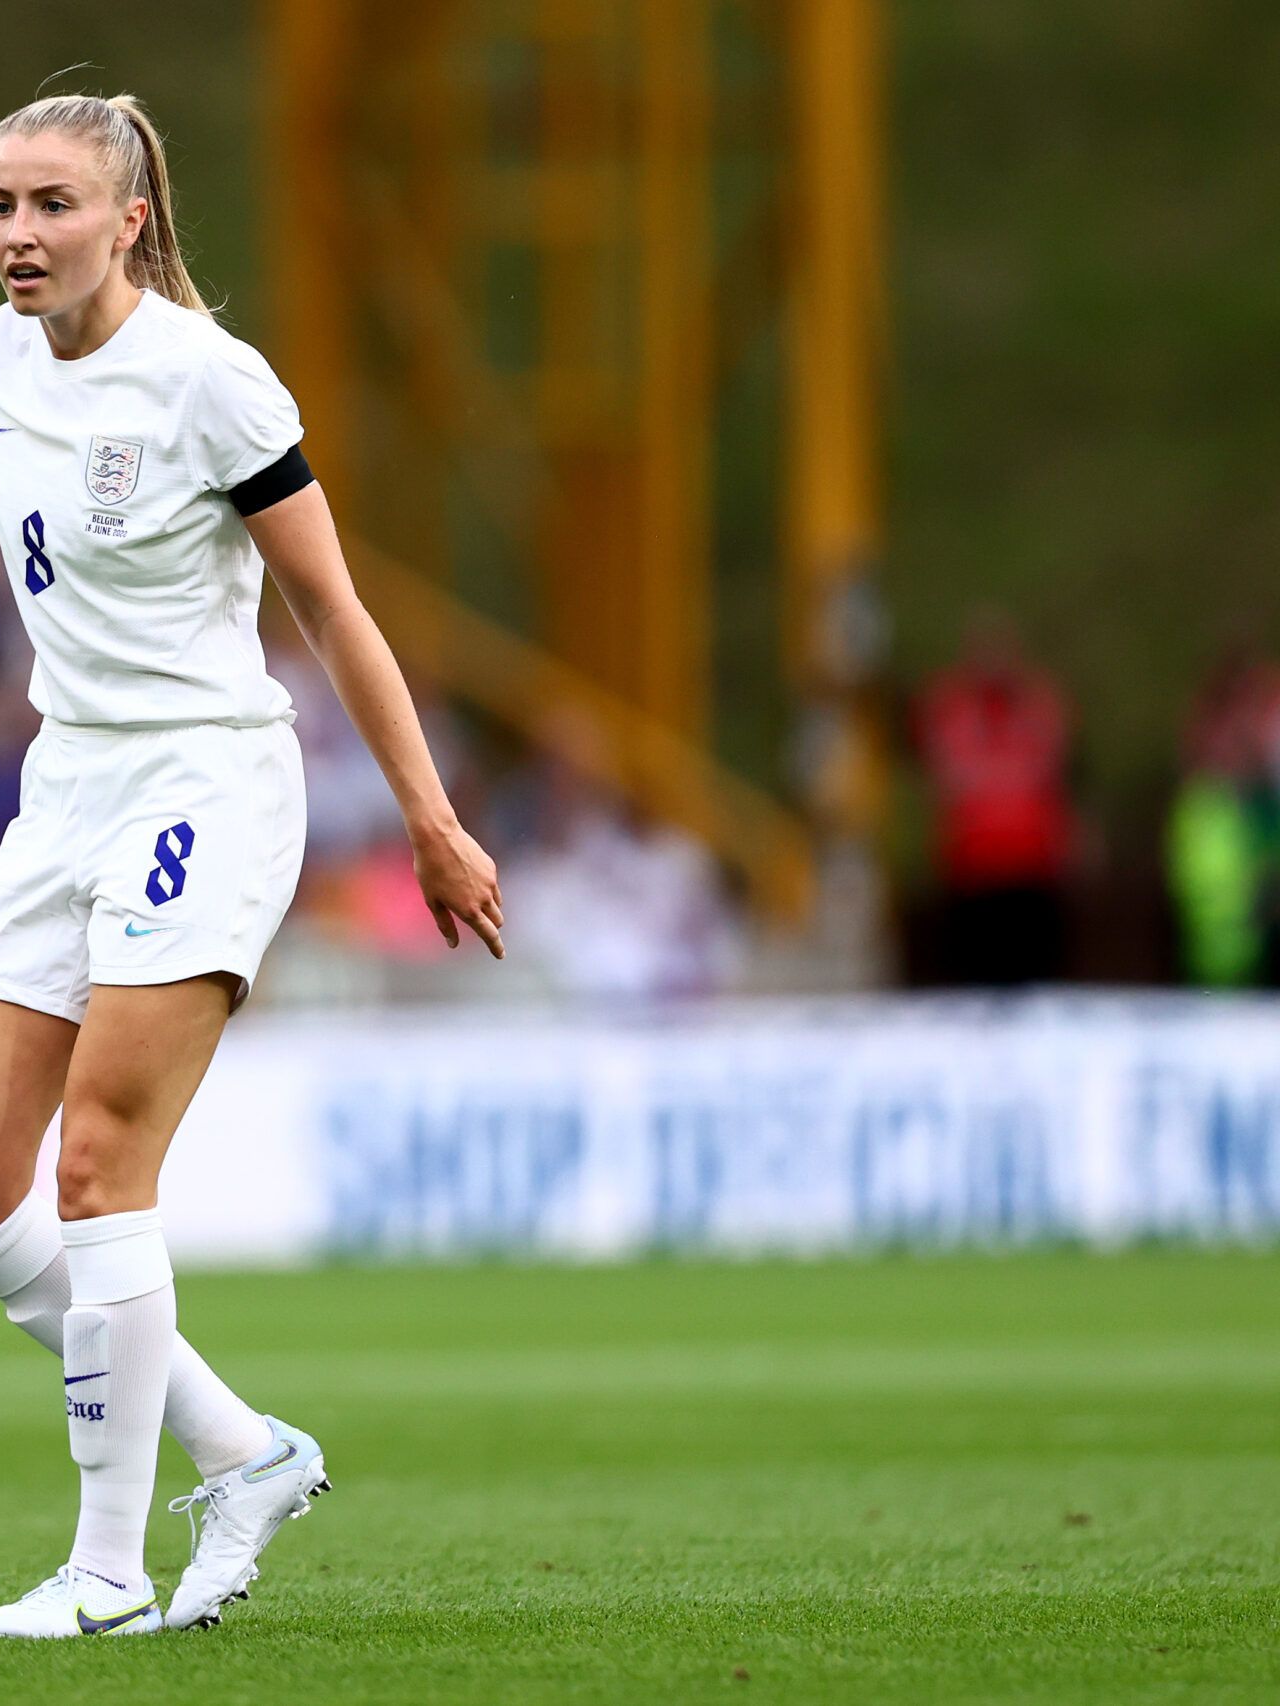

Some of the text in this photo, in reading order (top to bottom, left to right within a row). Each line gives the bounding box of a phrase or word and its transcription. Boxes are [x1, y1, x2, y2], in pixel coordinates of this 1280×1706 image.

[92, 513, 124, 528] BELGIUM
[93, 525, 112, 537] JUNE
[22, 509, 55, 596] 8
[145, 820, 195, 907] 8
